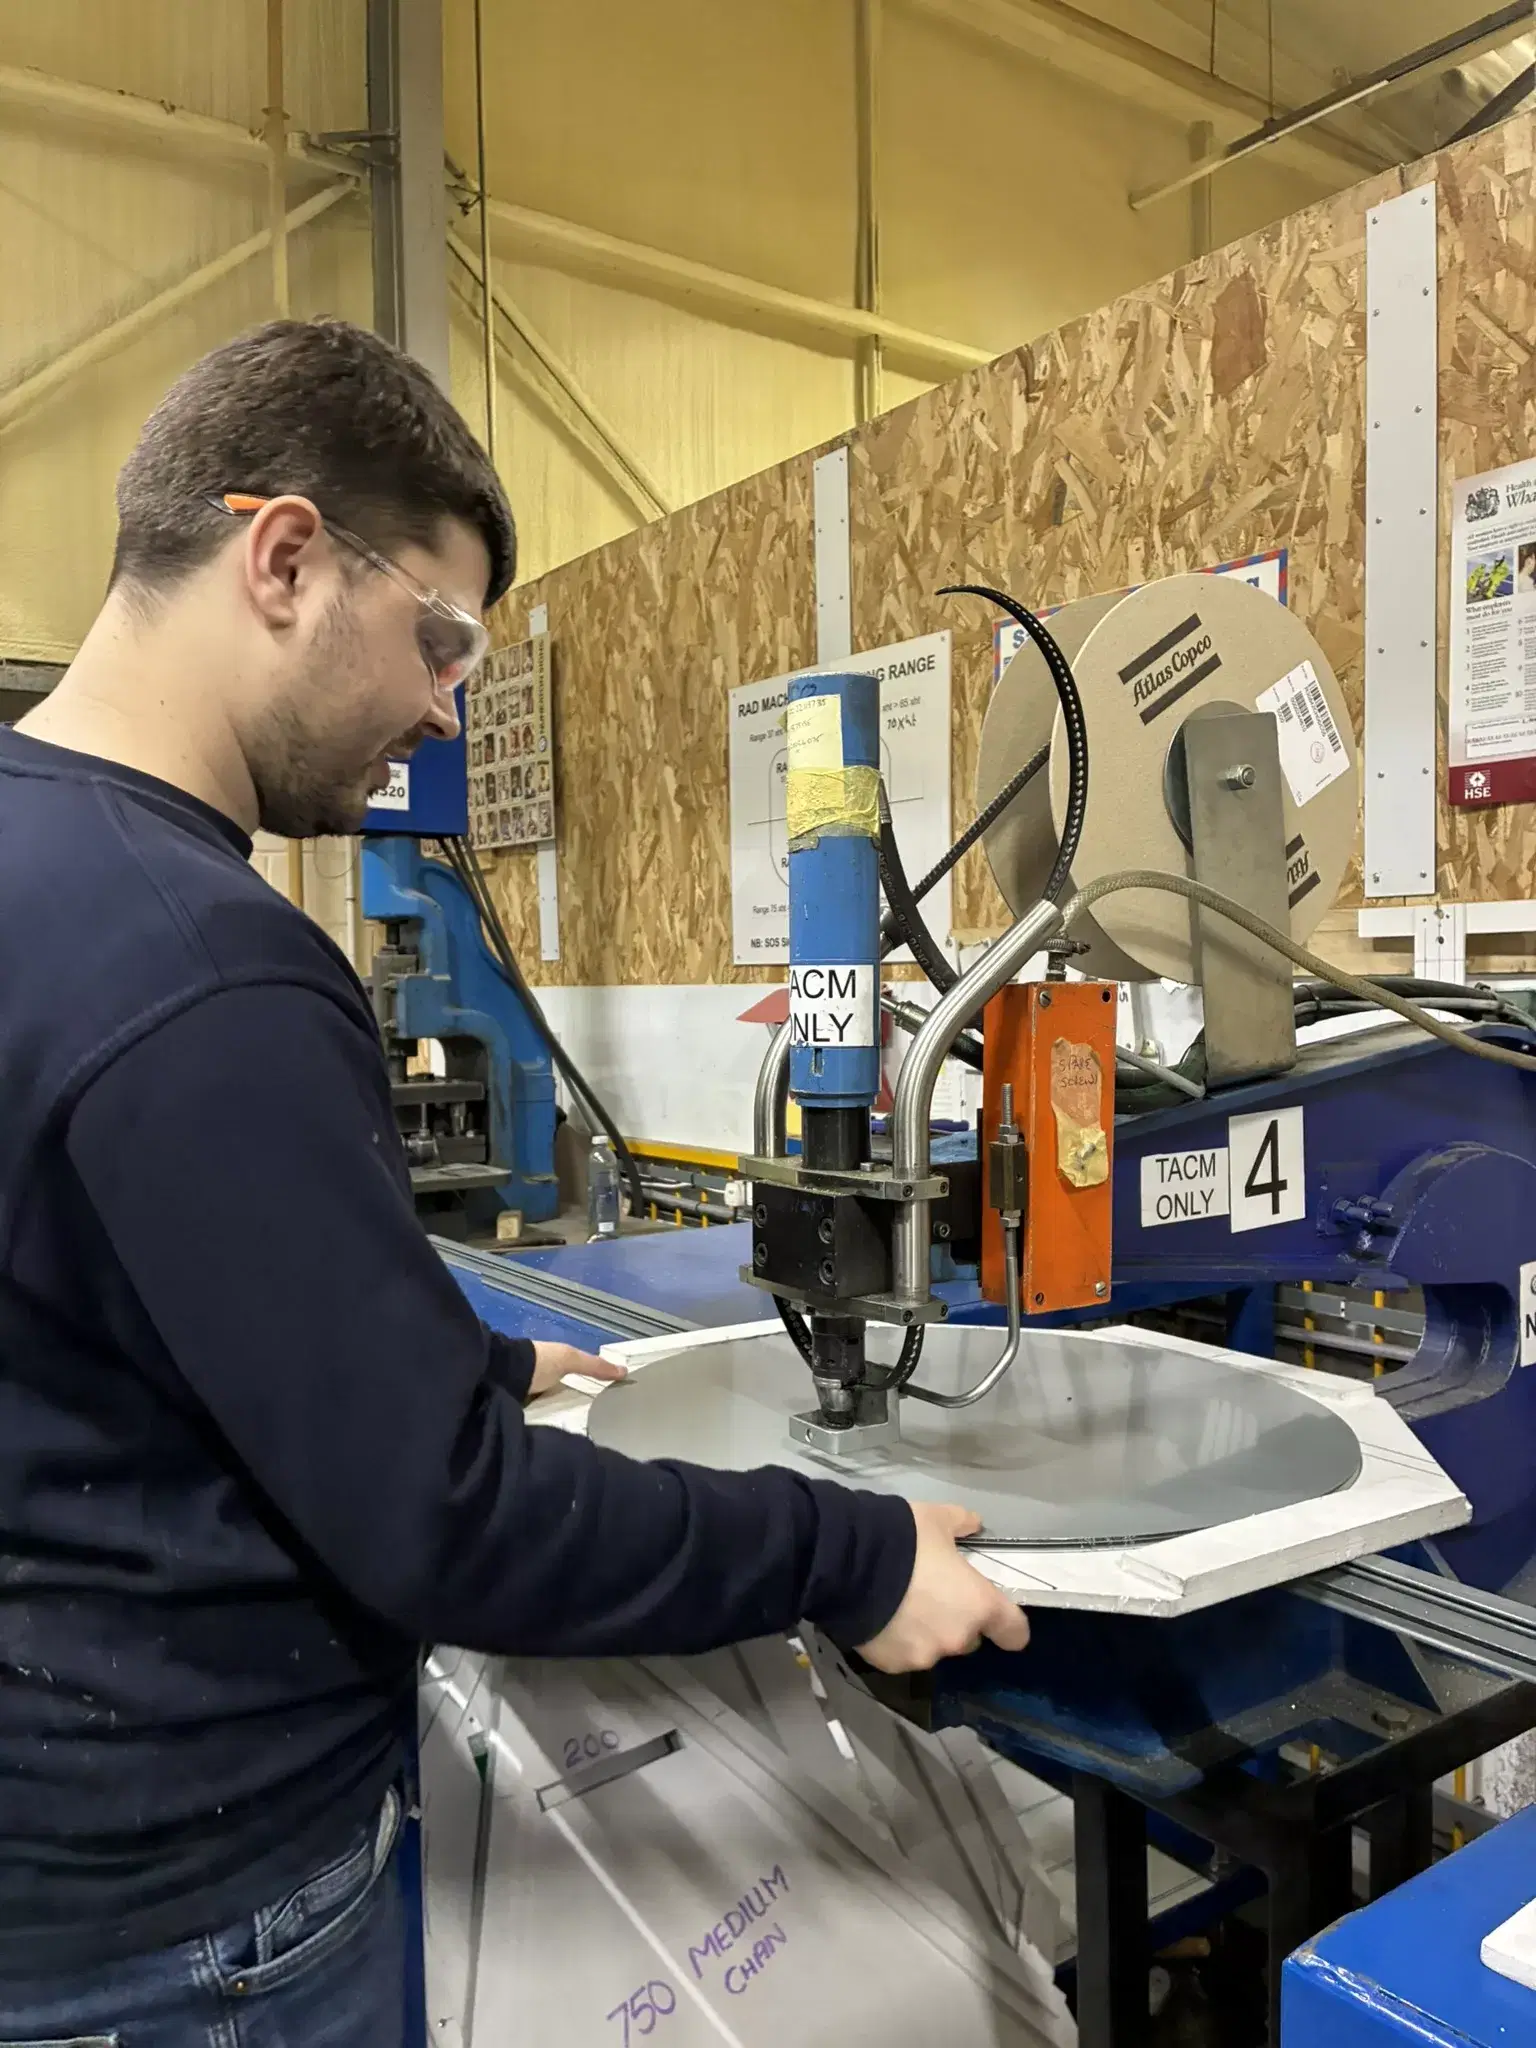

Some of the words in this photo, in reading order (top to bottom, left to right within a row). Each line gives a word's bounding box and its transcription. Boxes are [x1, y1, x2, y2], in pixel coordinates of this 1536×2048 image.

[1506, 479, 1532, 492] Health
[888, 655, 936, 681] RANGE
[1133, 664, 1173, 707] Atlas
[1171, 635, 1212, 673] Copco
[737, 700, 759, 718] RAD
[1464, 786, 1491, 800] HSE
[752, 905, 769, 915] Range
[750, 938, 763, 948] NB:
[764, 938, 780, 948] SOS
[790, 969, 856, 999] ACM
[790, 1013, 854, 1042] NLY
[1155, 1152, 1216, 1183] TACM
[1244, 1119, 1288, 1215] 4
[1155, 1189, 1215, 1221] ONLY
[563, 1729, 620, 1769] 200
[687, 1864, 791, 1979] MEDIUM
[606, 1979, 676, 2048] 750
[724, 1922, 788, 1995] CHAN
